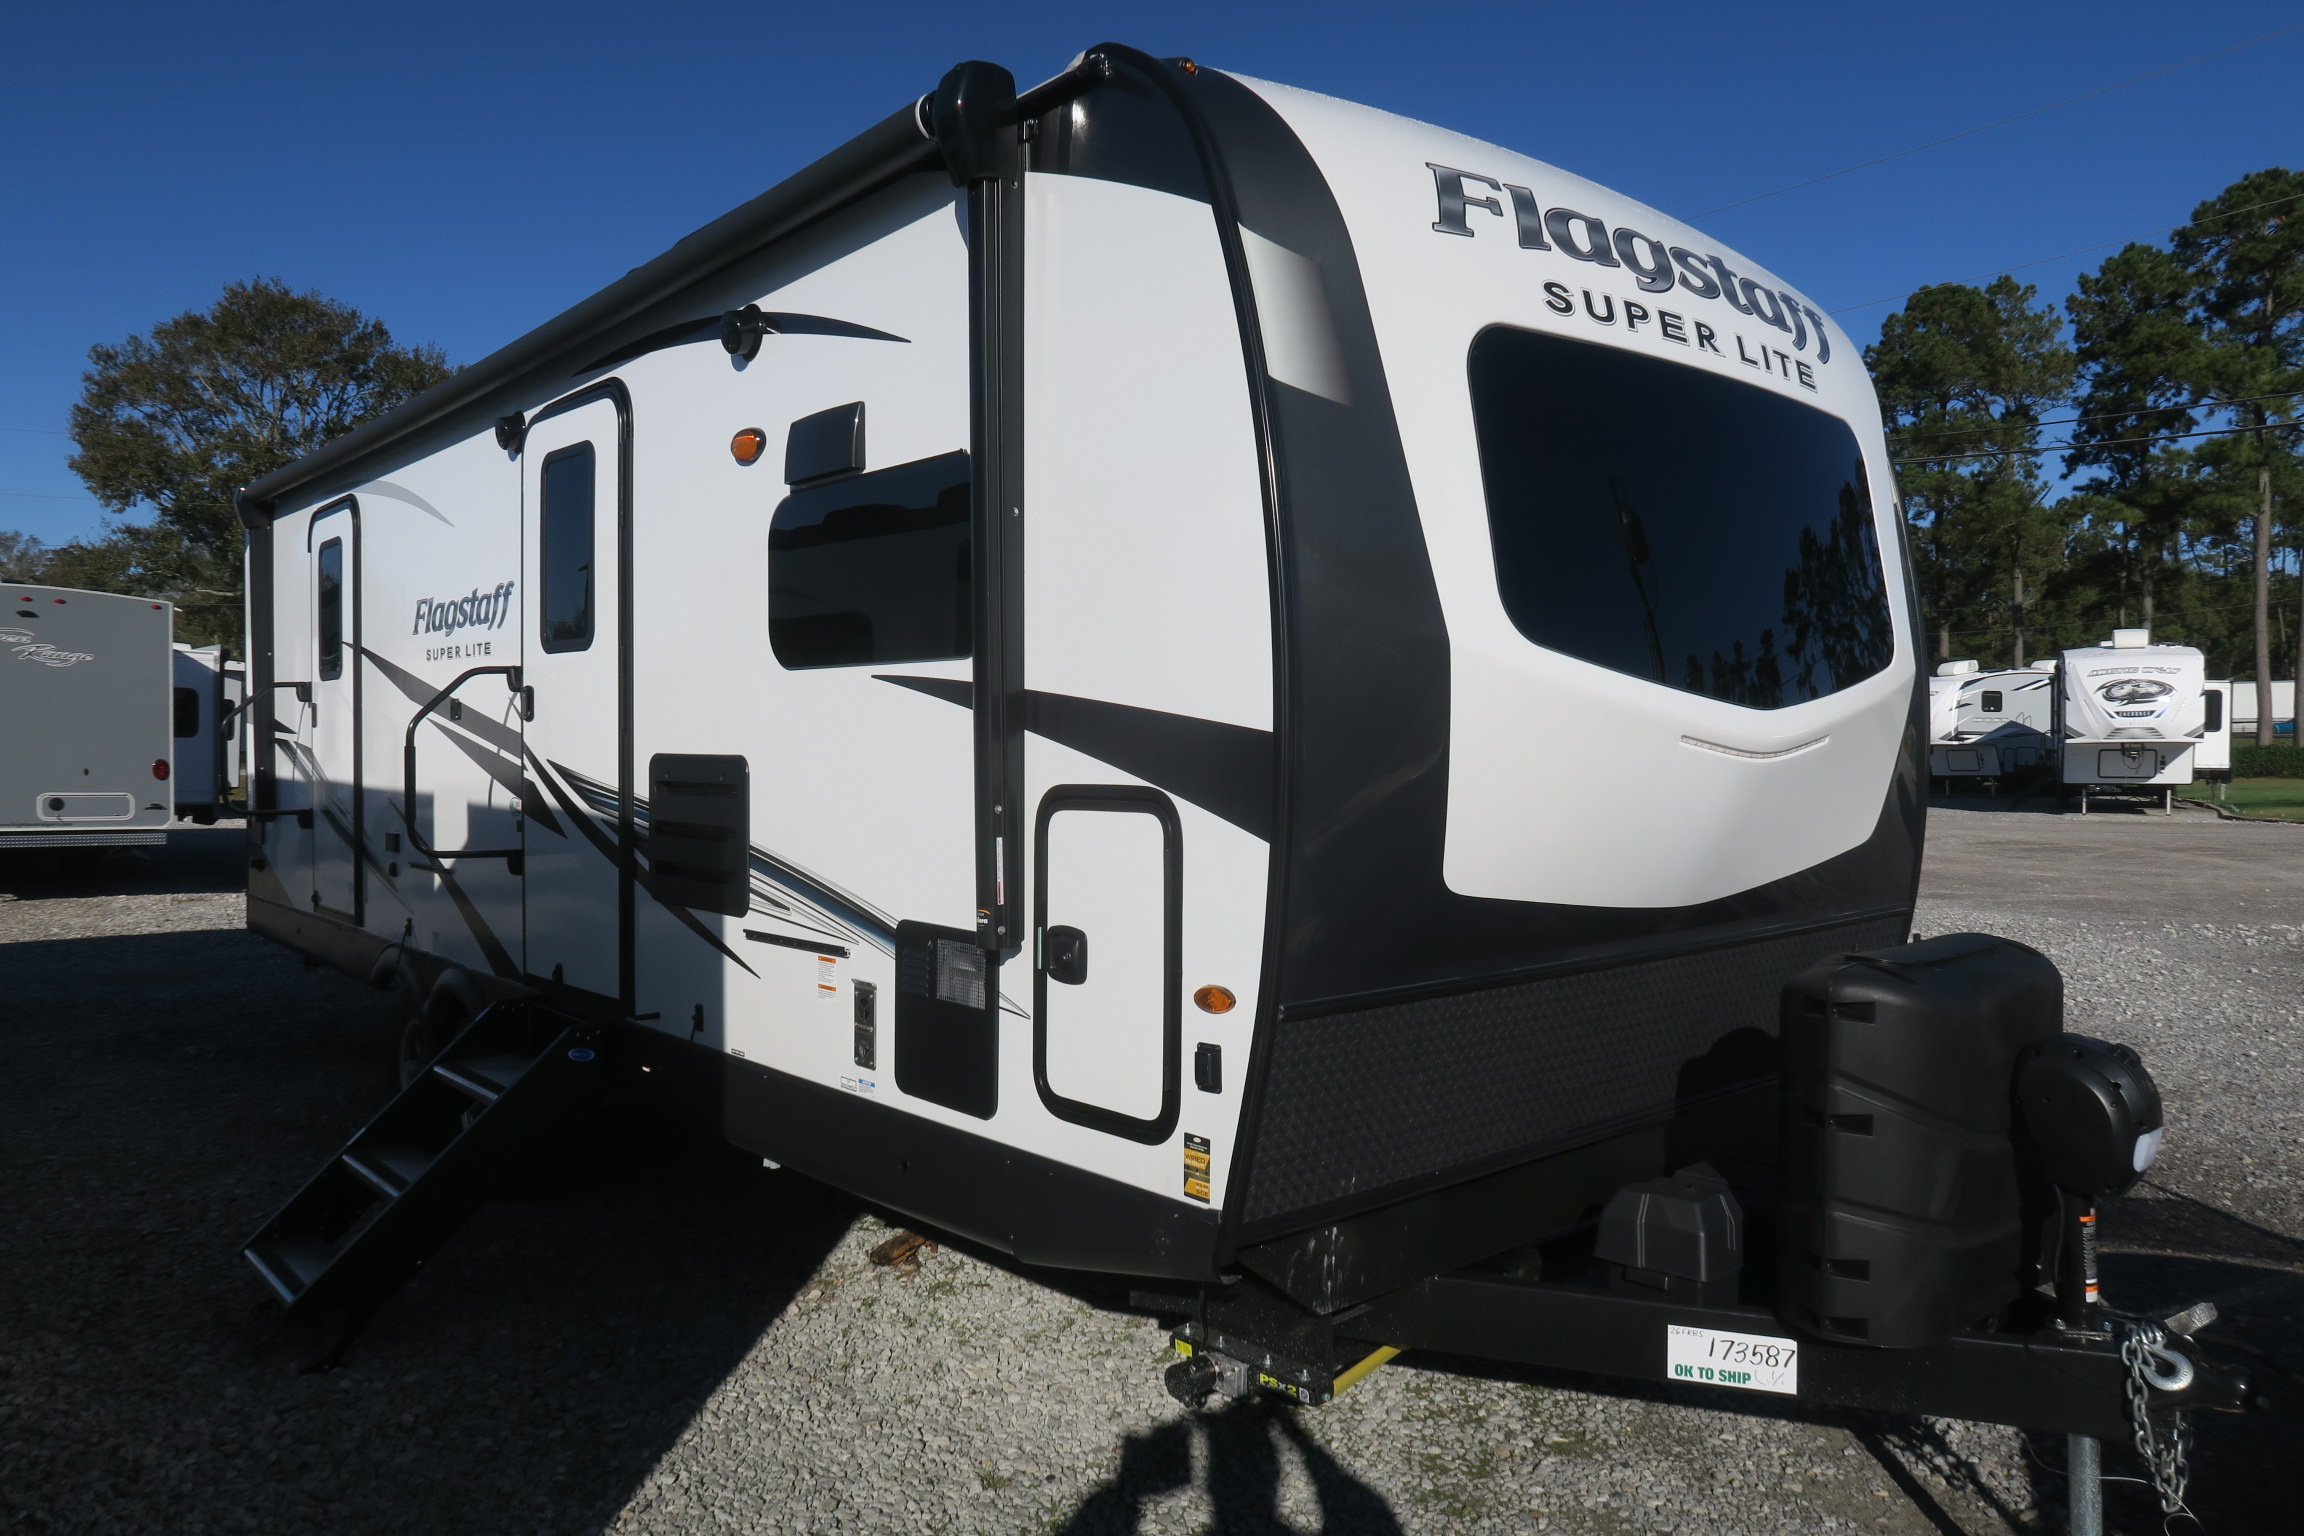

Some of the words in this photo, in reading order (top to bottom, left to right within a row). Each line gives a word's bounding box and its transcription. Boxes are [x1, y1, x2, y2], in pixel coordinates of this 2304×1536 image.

[1425, 162, 1831, 364] Flagstaff
[1541, 279, 1726, 358] SUPER
[1735, 332, 1819, 393] LITE
[412, 580, 515, 637] Flagstaff
[426, 646, 461, 661] SUPER
[465, 642, 492, 658] LITE
[1185, 1154, 1206, 1164] WIRED
[1708, 1337, 1796, 1369] 173587
[1674, 1363, 1694, 1378] OK
[1697, 1366, 1714, 1381] TO
[1718, 1369, 1751, 1384] SHIP
